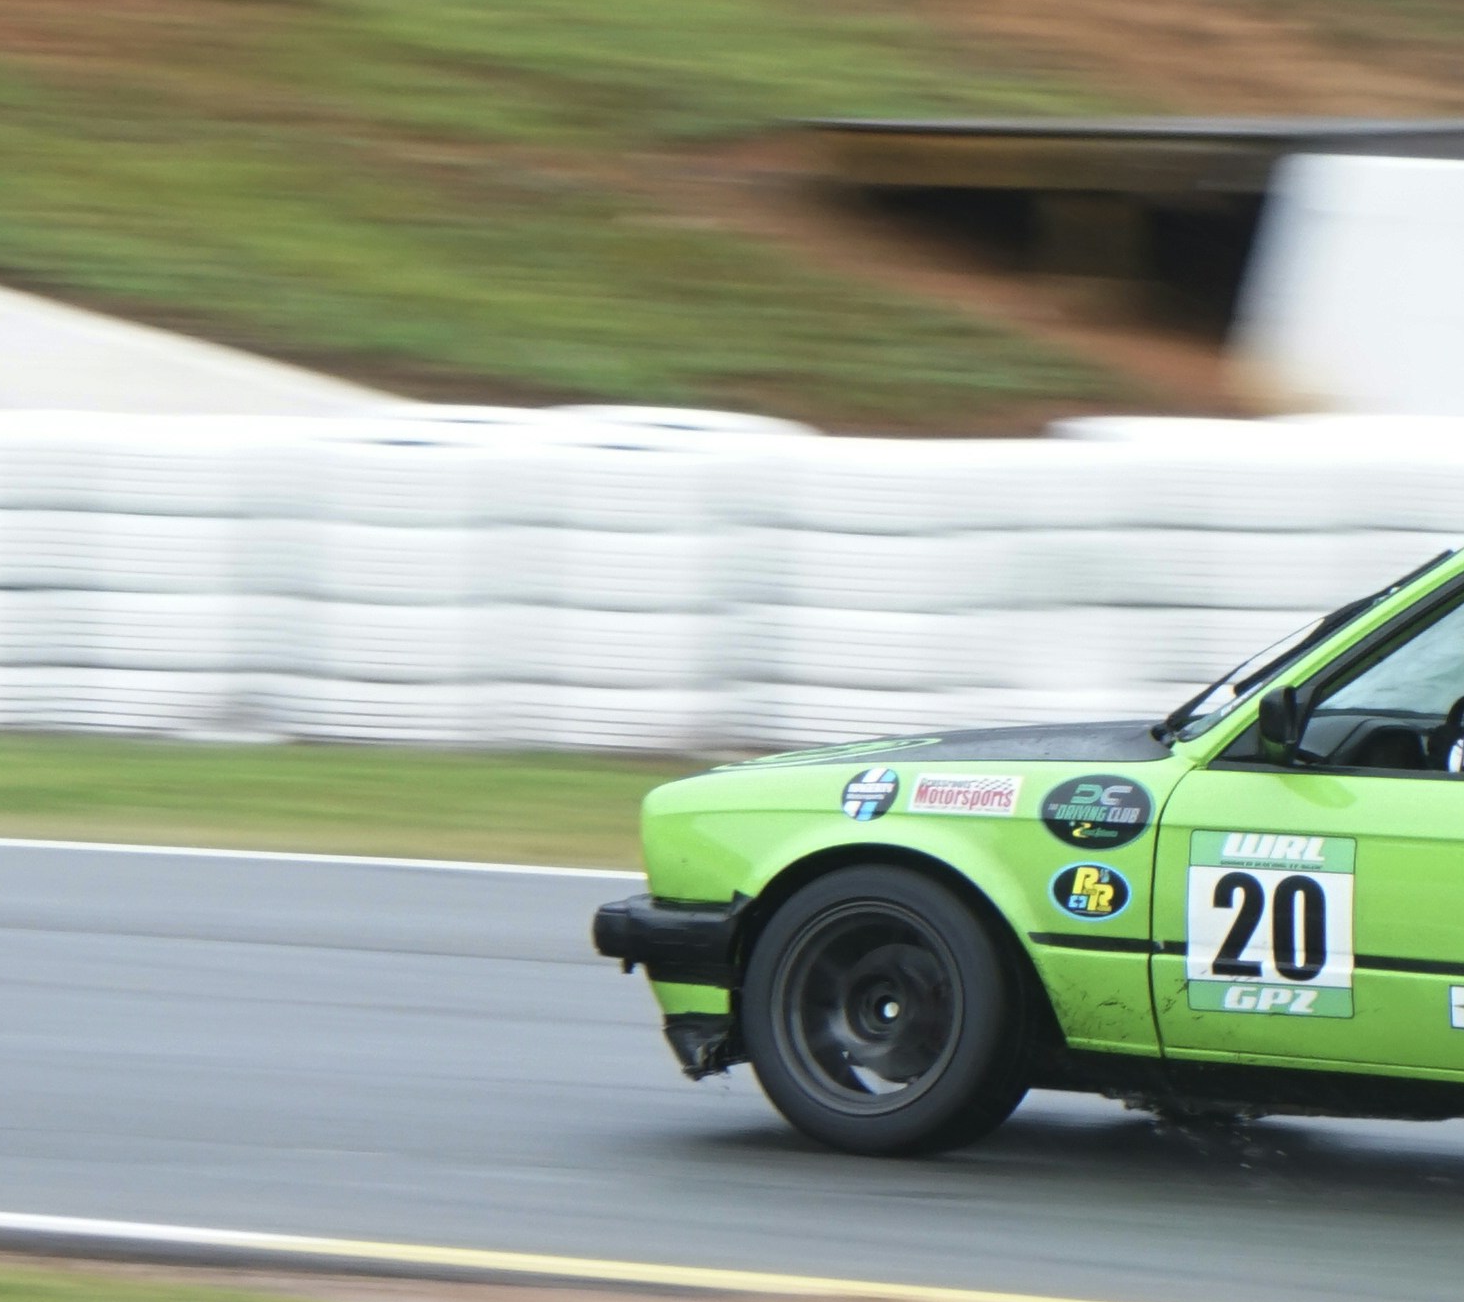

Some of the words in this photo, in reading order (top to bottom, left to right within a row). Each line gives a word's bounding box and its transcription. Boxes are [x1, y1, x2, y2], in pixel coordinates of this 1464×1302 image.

[915, 785, 1014, 810] Motorsports
[1055, 804, 1109, 822] DRIVING
[1106, 807, 1140, 824] CLUB
[1222, 832, 1325, 861] WRL
[1212, 871, 1327, 981] 20
